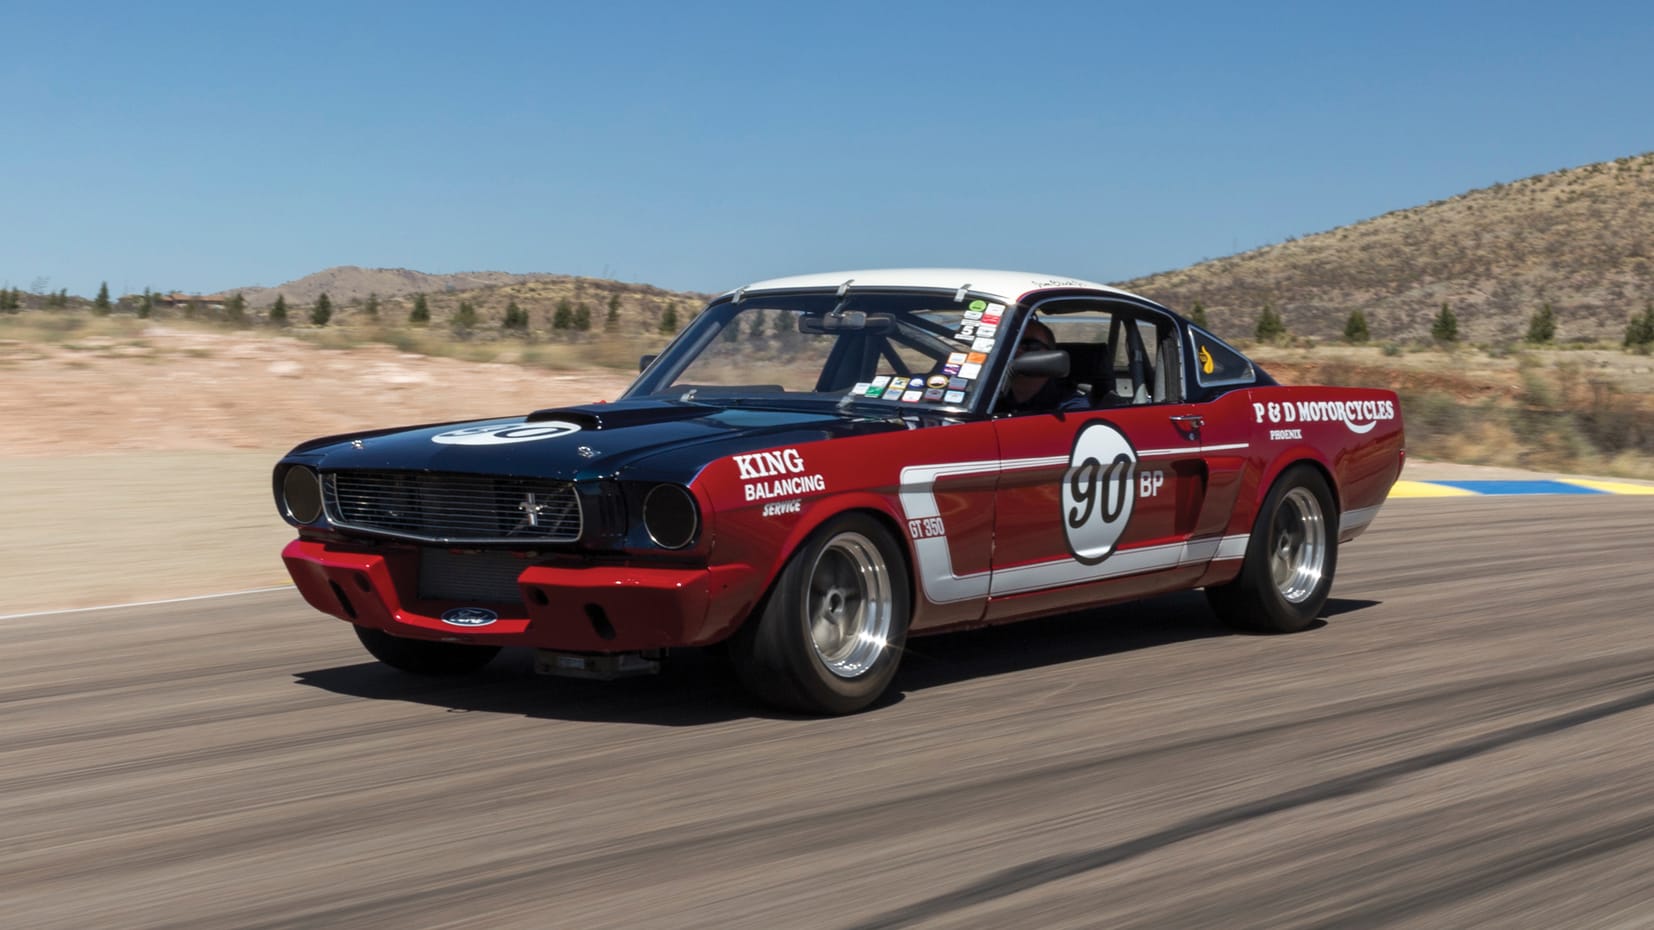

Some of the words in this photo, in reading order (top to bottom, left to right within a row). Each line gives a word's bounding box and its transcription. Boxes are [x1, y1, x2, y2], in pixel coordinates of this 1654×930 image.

[1253, 402, 1265, 423] P
[1268, 402, 1281, 423] &
[1282, 402, 1296, 422] D
[1296, 400, 1395, 431] MOTORCYCLES
[1270, 429, 1302, 440] PHOENIX
[732, 448, 805, 480] KING
[744, 474, 825, 501] BALANCING
[1069, 453, 1133, 529] 90
[1140, 470, 1164, 498] BP
[762, 499, 802, 517] SERVICE
[908, 519, 924, 538] GT
[923, 517, 945, 537] 350
